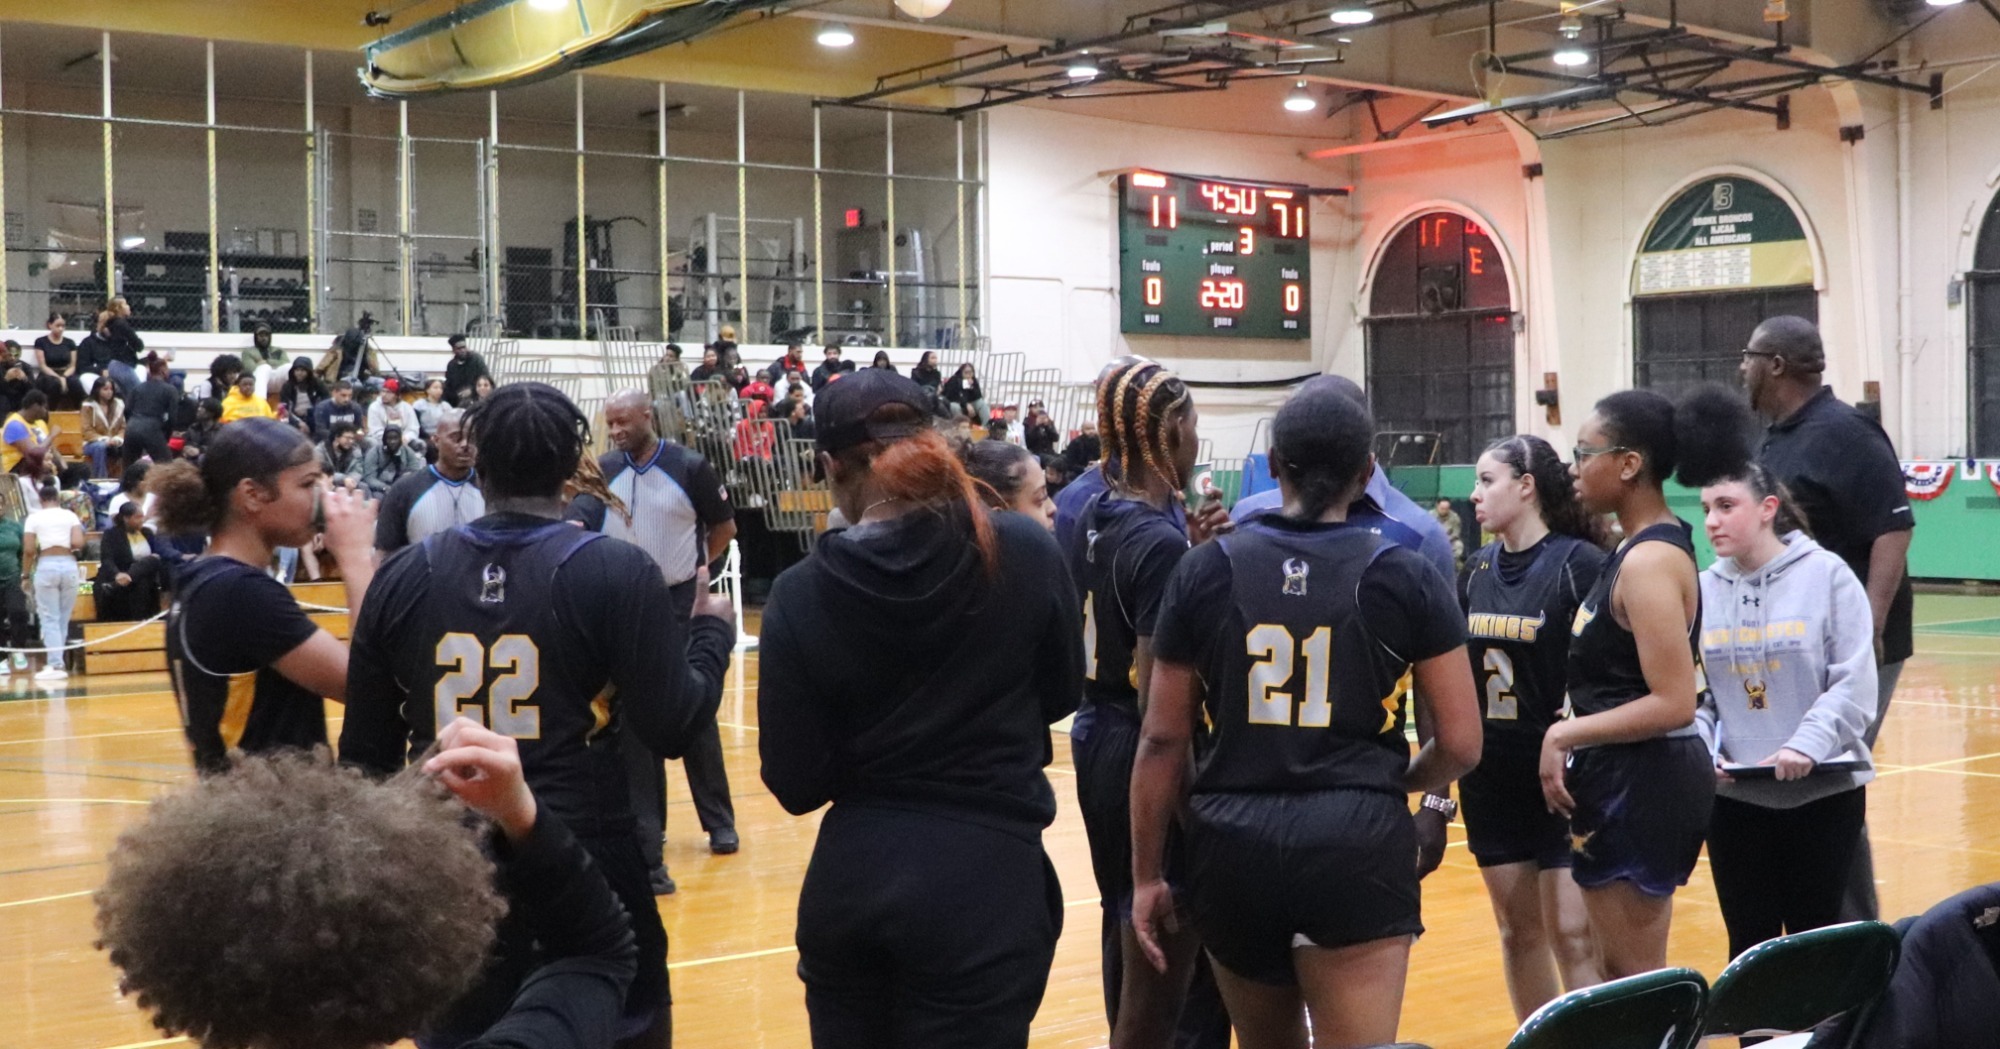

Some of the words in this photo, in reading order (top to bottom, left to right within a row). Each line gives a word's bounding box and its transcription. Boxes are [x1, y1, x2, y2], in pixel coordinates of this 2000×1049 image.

[1152, 195, 1176, 228] 11
[1202, 184, 1256, 215] 4:50
[1272, 203, 1303, 237] 71
[1693, 215, 1717, 226] BRONX
[1719, 212, 1753, 223] BRONCOS
[1710, 224, 1735, 234] NJCAA
[1210, 241, 1234, 253] period
[1240, 227, 1254, 254] 3
[1694, 236, 1708, 246] ALL
[1710, 233, 1752, 245] AMERICANS
[1210, 262, 1235, 276] player
[1147, 278, 1161, 305] 0
[1285, 285, 1299, 311] 0
[1468, 610, 1546, 643] VIKINGS
[435, 632, 540, 740] 22
[1246, 623, 1332, 728] 21
[1483, 648, 1518, 720] 2
